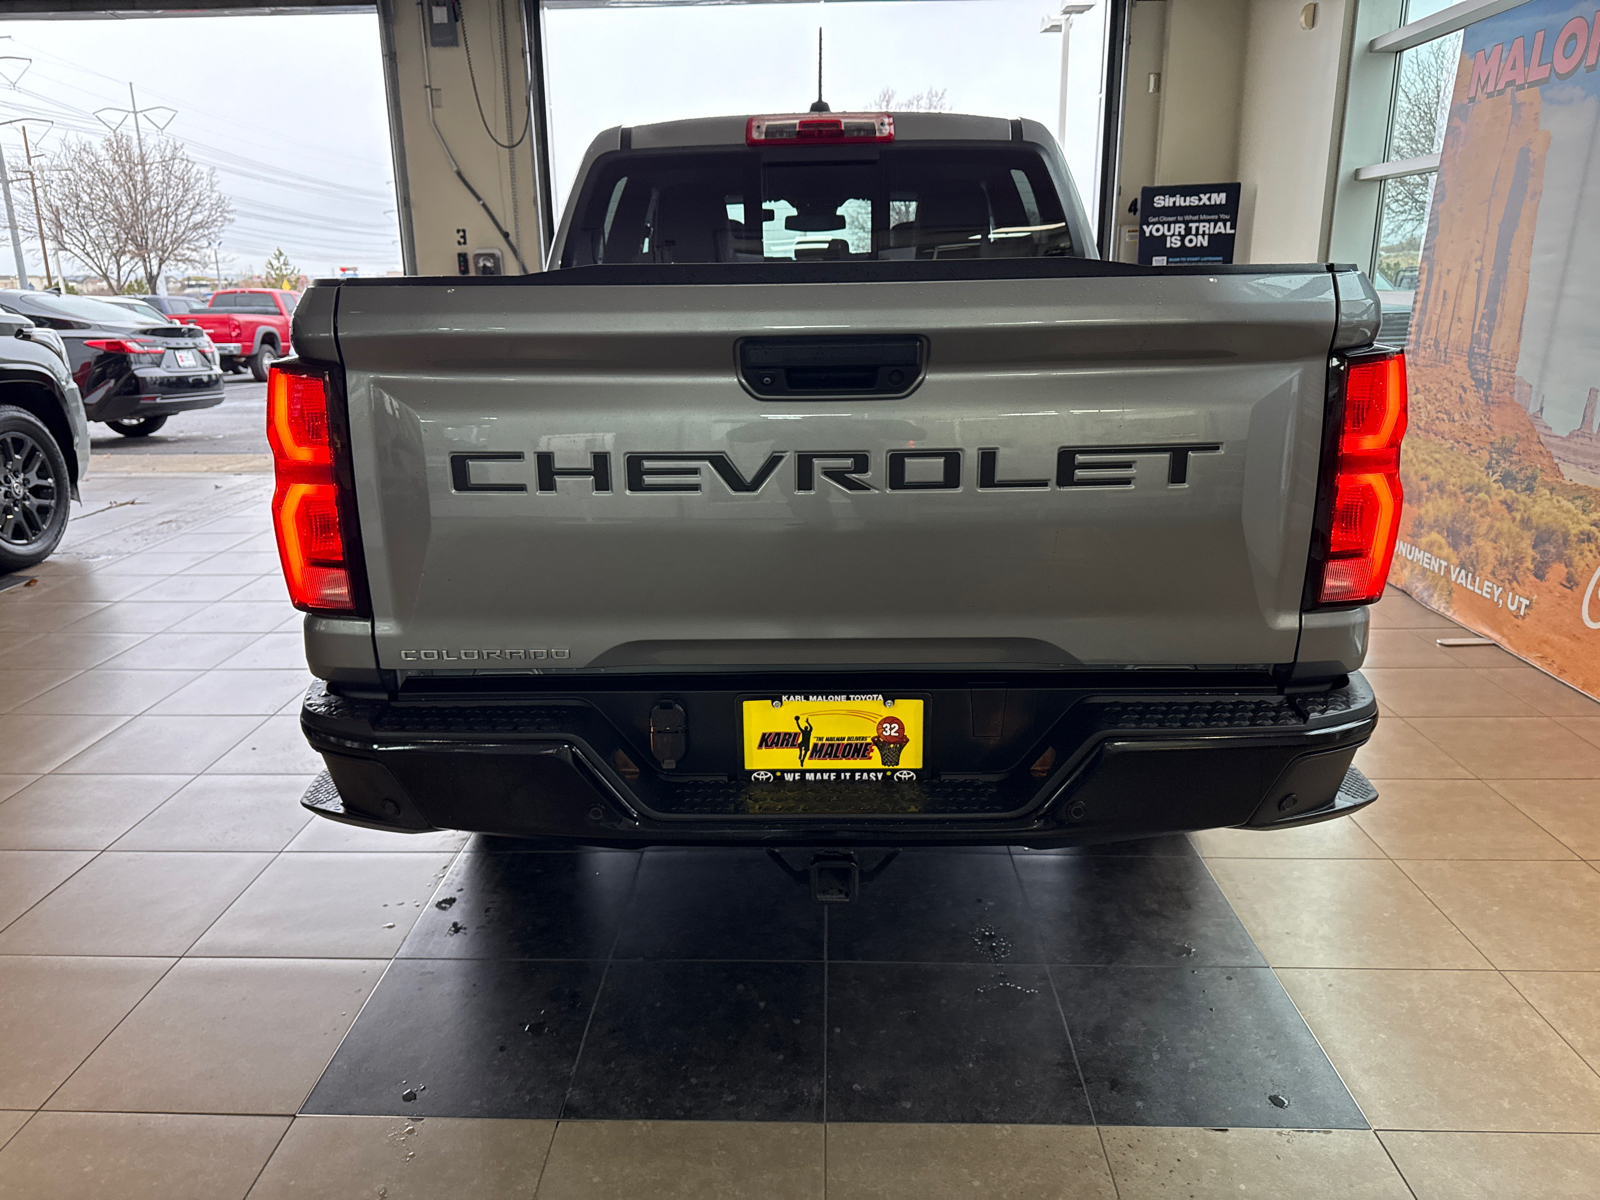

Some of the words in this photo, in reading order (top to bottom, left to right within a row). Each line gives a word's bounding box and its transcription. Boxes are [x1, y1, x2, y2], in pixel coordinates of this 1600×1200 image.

[1127, 197, 1138, 216] 4
[1153, 192, 1226, 208] SiriusXM
[456, 228, 467, 246] 3
[1142, 222, 1186, 237] YOUR
[1188, 221, 1236, 235] TRIAL
[1166, 236, 1182, 248] IS
[1184, 234, 1209, 248] ON
[449, 441, 1222, 494] CHEVROLET
[1395, 539, 1447, 576] NUMENT
[1450, 565, 1503, 608] VALLEY,
[1507, 592, 1530, 616] UT
[400, 649, 571, 661] COLORADO
[882, 723, 899, 737] 32
[757, 732, 801, 750] KARL
[808, 742, 874, 760] MALONE
[784, 772, 800, 781] WE
[806, 772, 836, 781] MAKE
[841, 772, 850, 780] IT
[855, 772, 884, 781] EASY
